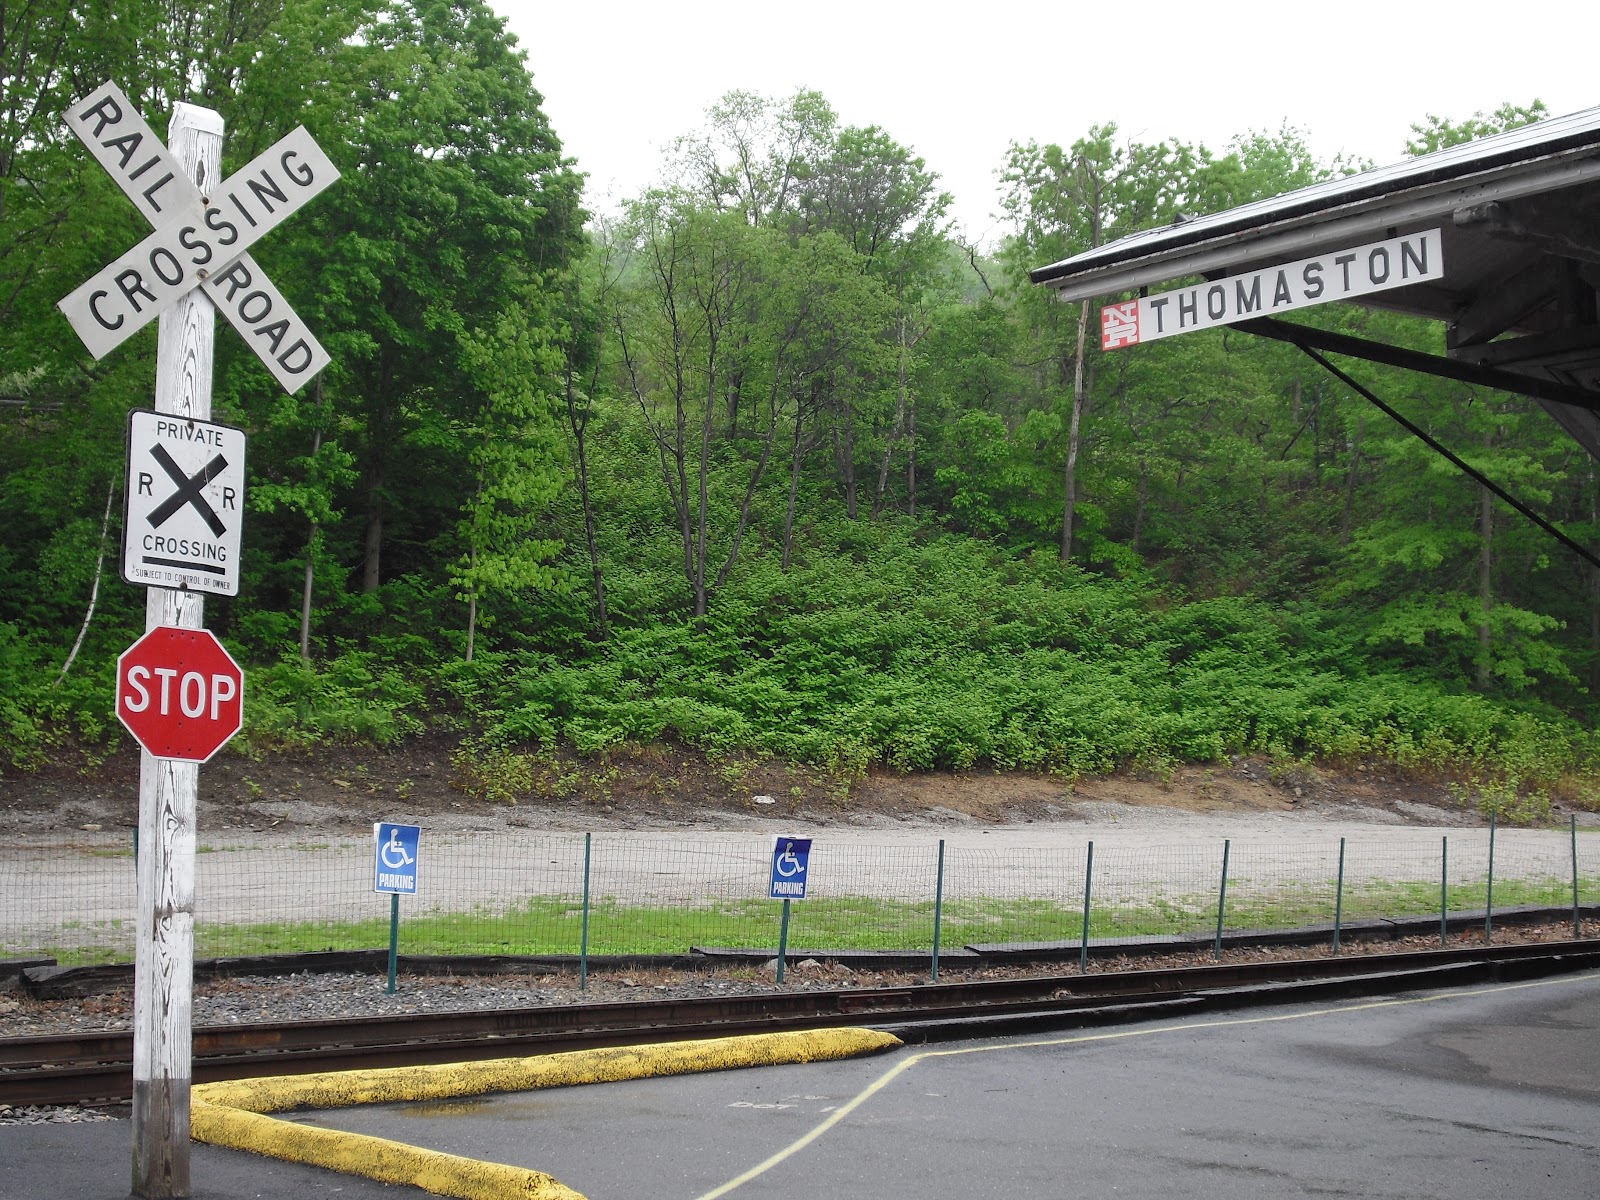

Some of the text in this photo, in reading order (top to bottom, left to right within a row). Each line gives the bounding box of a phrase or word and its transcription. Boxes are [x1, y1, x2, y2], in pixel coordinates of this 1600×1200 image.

[79, 95, 313, 375] RAIL ROAD
[88, 150, 314, 331] CROSSING
[1150, 236, 1428, 333] THOMASTON
[157, 421, 223, 447] PRIVATE
[138, 472, 153, 496] R
[222, 487, 236, 510] R
[142, 534, 226, 562] CROSSING
[135, 568, 231, 590] SUBJECT TO CONTROL OF OWNER
[124, 665, 236, 720] STOP
[378, 873, 414, 890] PARKING
[773, 881, 804, 895] PARKING
